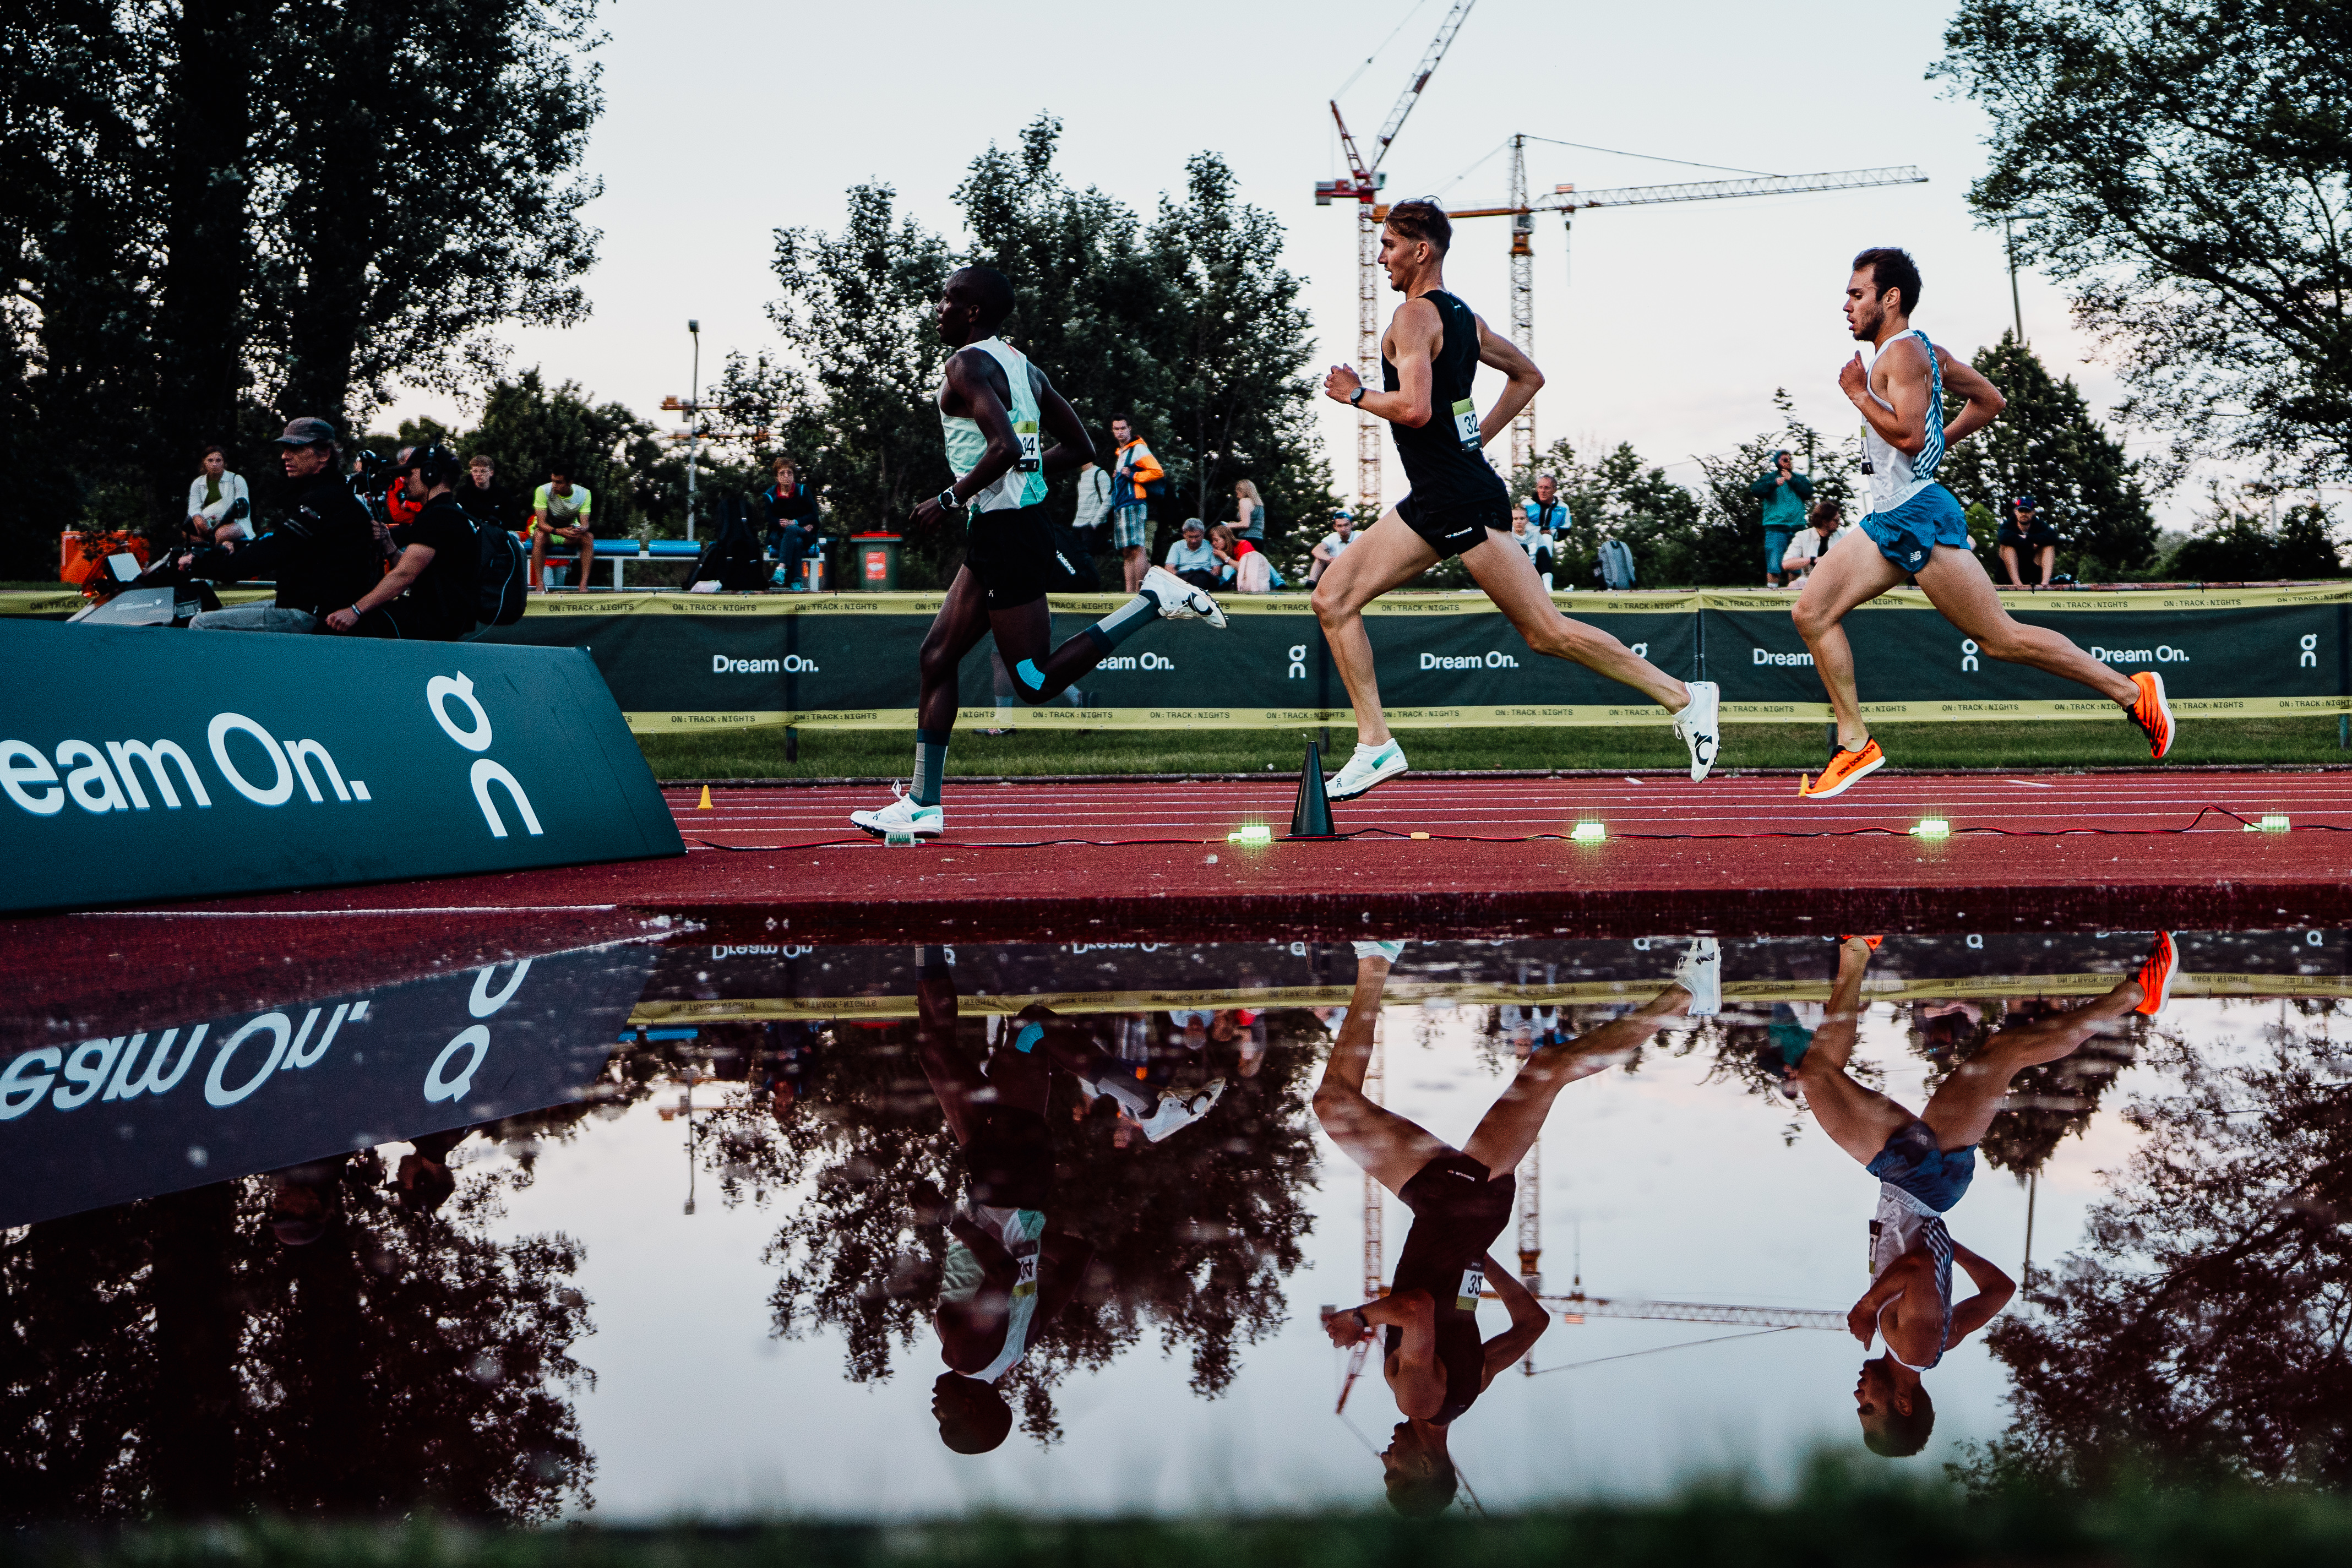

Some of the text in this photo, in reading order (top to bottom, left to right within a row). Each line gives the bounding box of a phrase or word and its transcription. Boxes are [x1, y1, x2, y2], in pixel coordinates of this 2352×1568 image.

[1464, 413, 1480, 434] 32
[549, 603, 634, 612] ON:TRACK:NIGHTS
[1096, 652, 1174, 671] eam On.
[1420, 651, 1520, 670] Dream On.
[1754, 648, 1814, 666] Dream
[2091, 645, 2190, 662] Dream On.
[714, 654, 819, 673] Dream On.
[0, 712, 372, 816] eam On.
[1837, 744, 1875, 777] new balance
